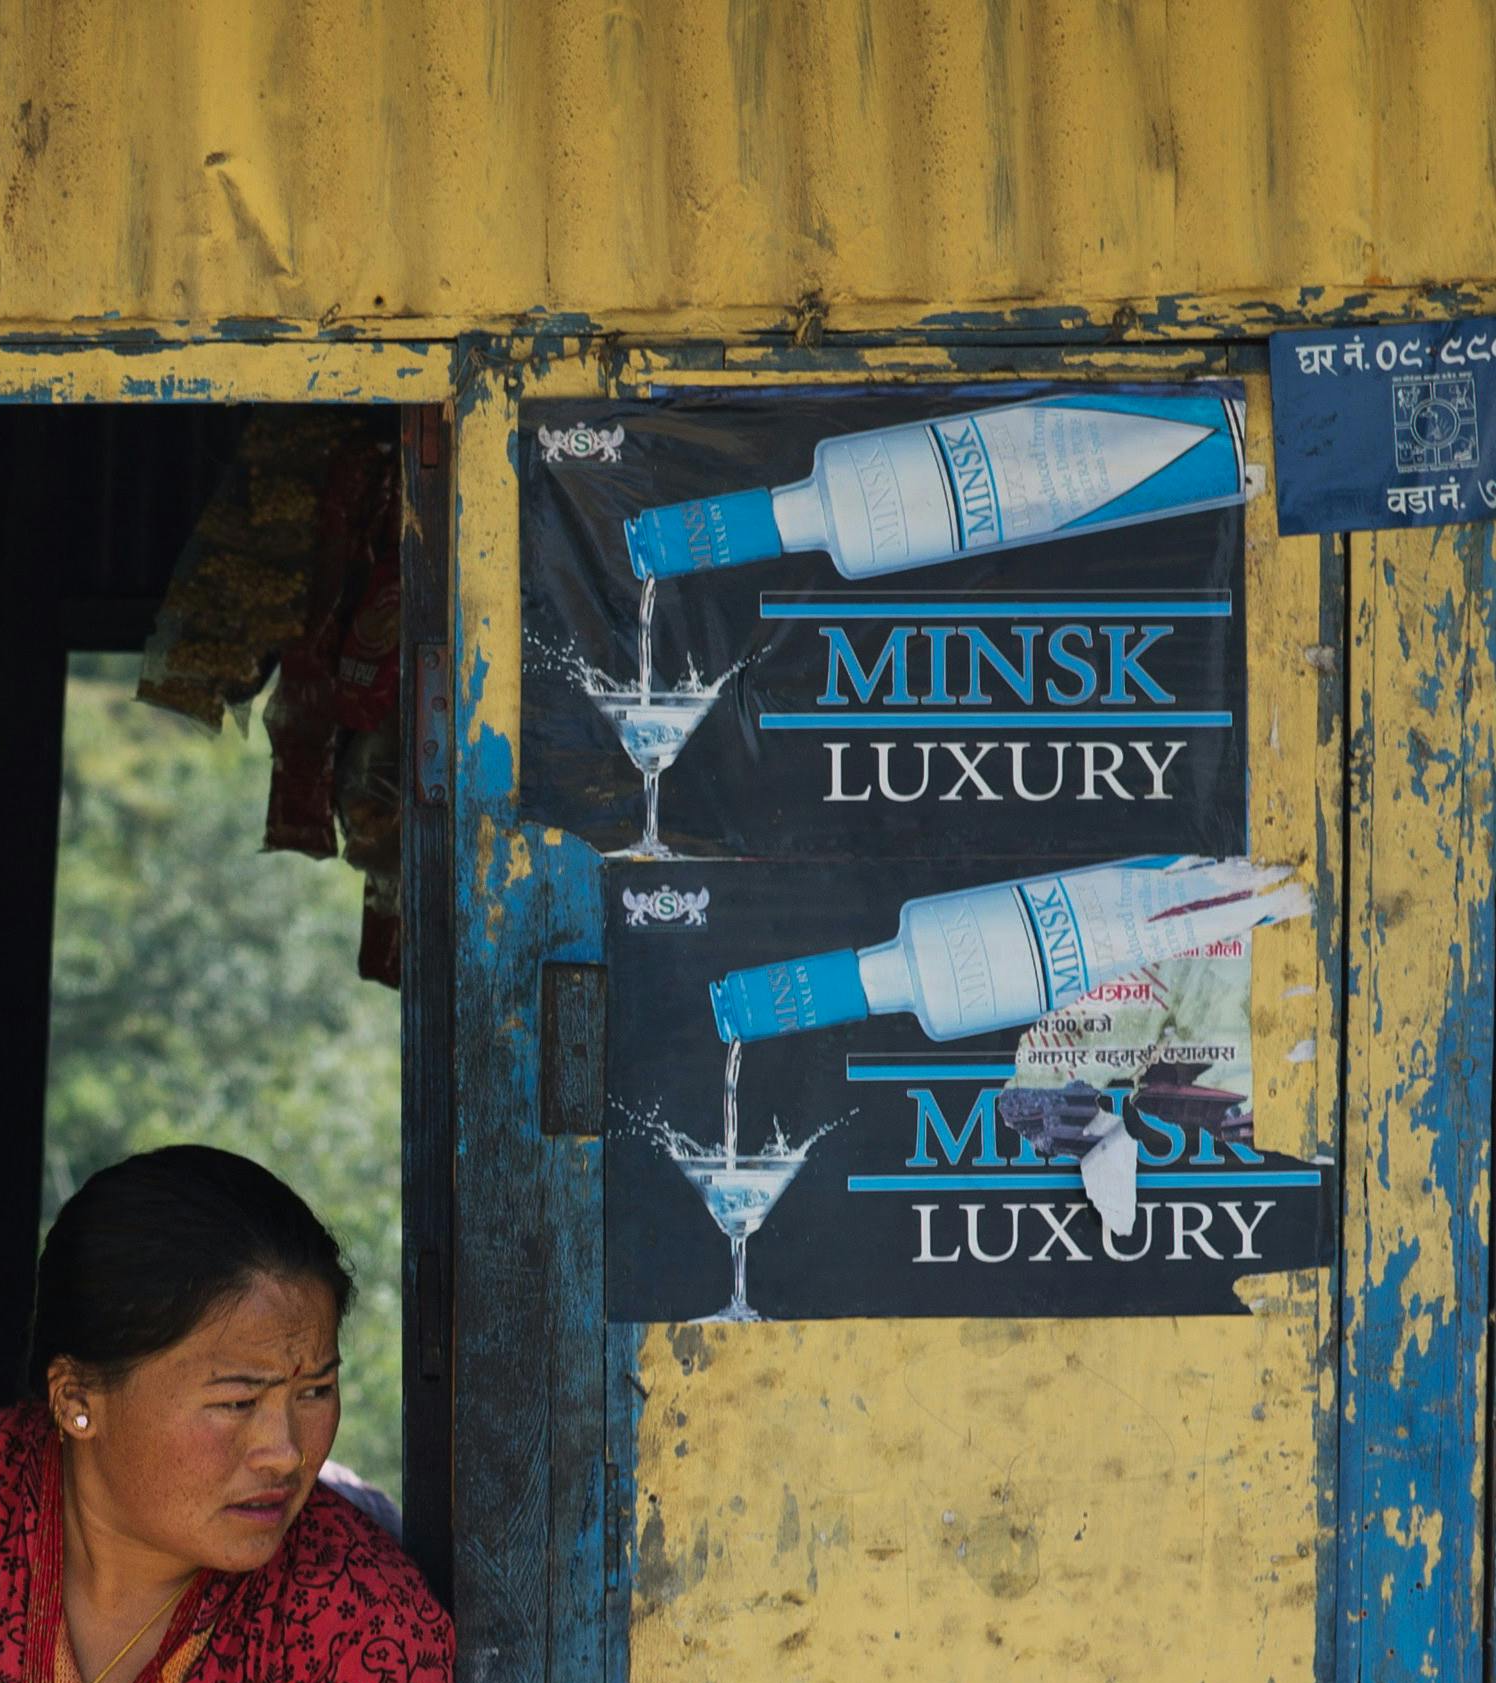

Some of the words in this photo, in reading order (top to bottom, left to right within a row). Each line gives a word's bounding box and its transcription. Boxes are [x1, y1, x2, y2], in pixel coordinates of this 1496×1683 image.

[1296, 344, 1338, 376] घर
[943, 425, 995, 547] MINSK
[1387, 484, 1437, 516] वडा
[817, 626, 1176, 705] MINSK
[823, 741, 1187, 802] LUXURY
[1030, 886, 1082, 999] MINSK
[1084, 1013, 1111, 1033] बजे
[1028, 1049, 1087, 1067] भक्तपुर
[911, 1200, 1277, 1263] LUXURY
